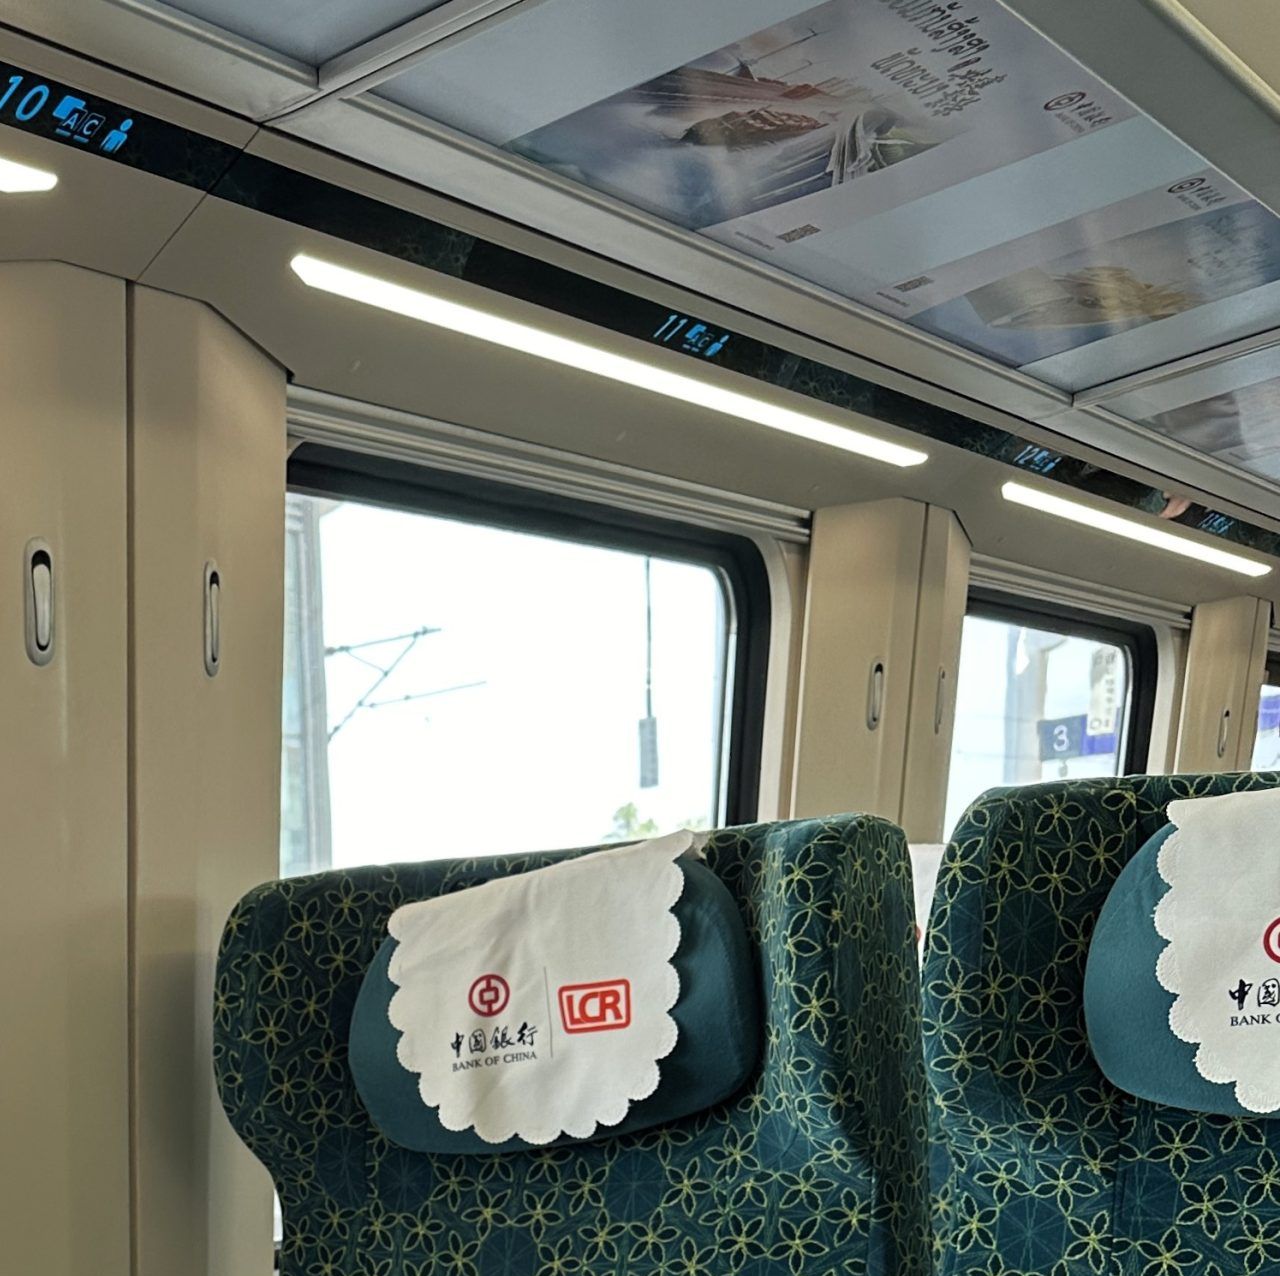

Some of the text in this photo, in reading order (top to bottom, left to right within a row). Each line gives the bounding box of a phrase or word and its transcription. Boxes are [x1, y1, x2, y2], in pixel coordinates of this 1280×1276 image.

[653, 314, 688, 341] 11
[1052, 725, 1070, 752] 3
[565, 988, 624, 1026] LCR
[1230, 1013, 1272, 1027] BANK
[452, 1051, 538, 1073] BANK OF CHINA
